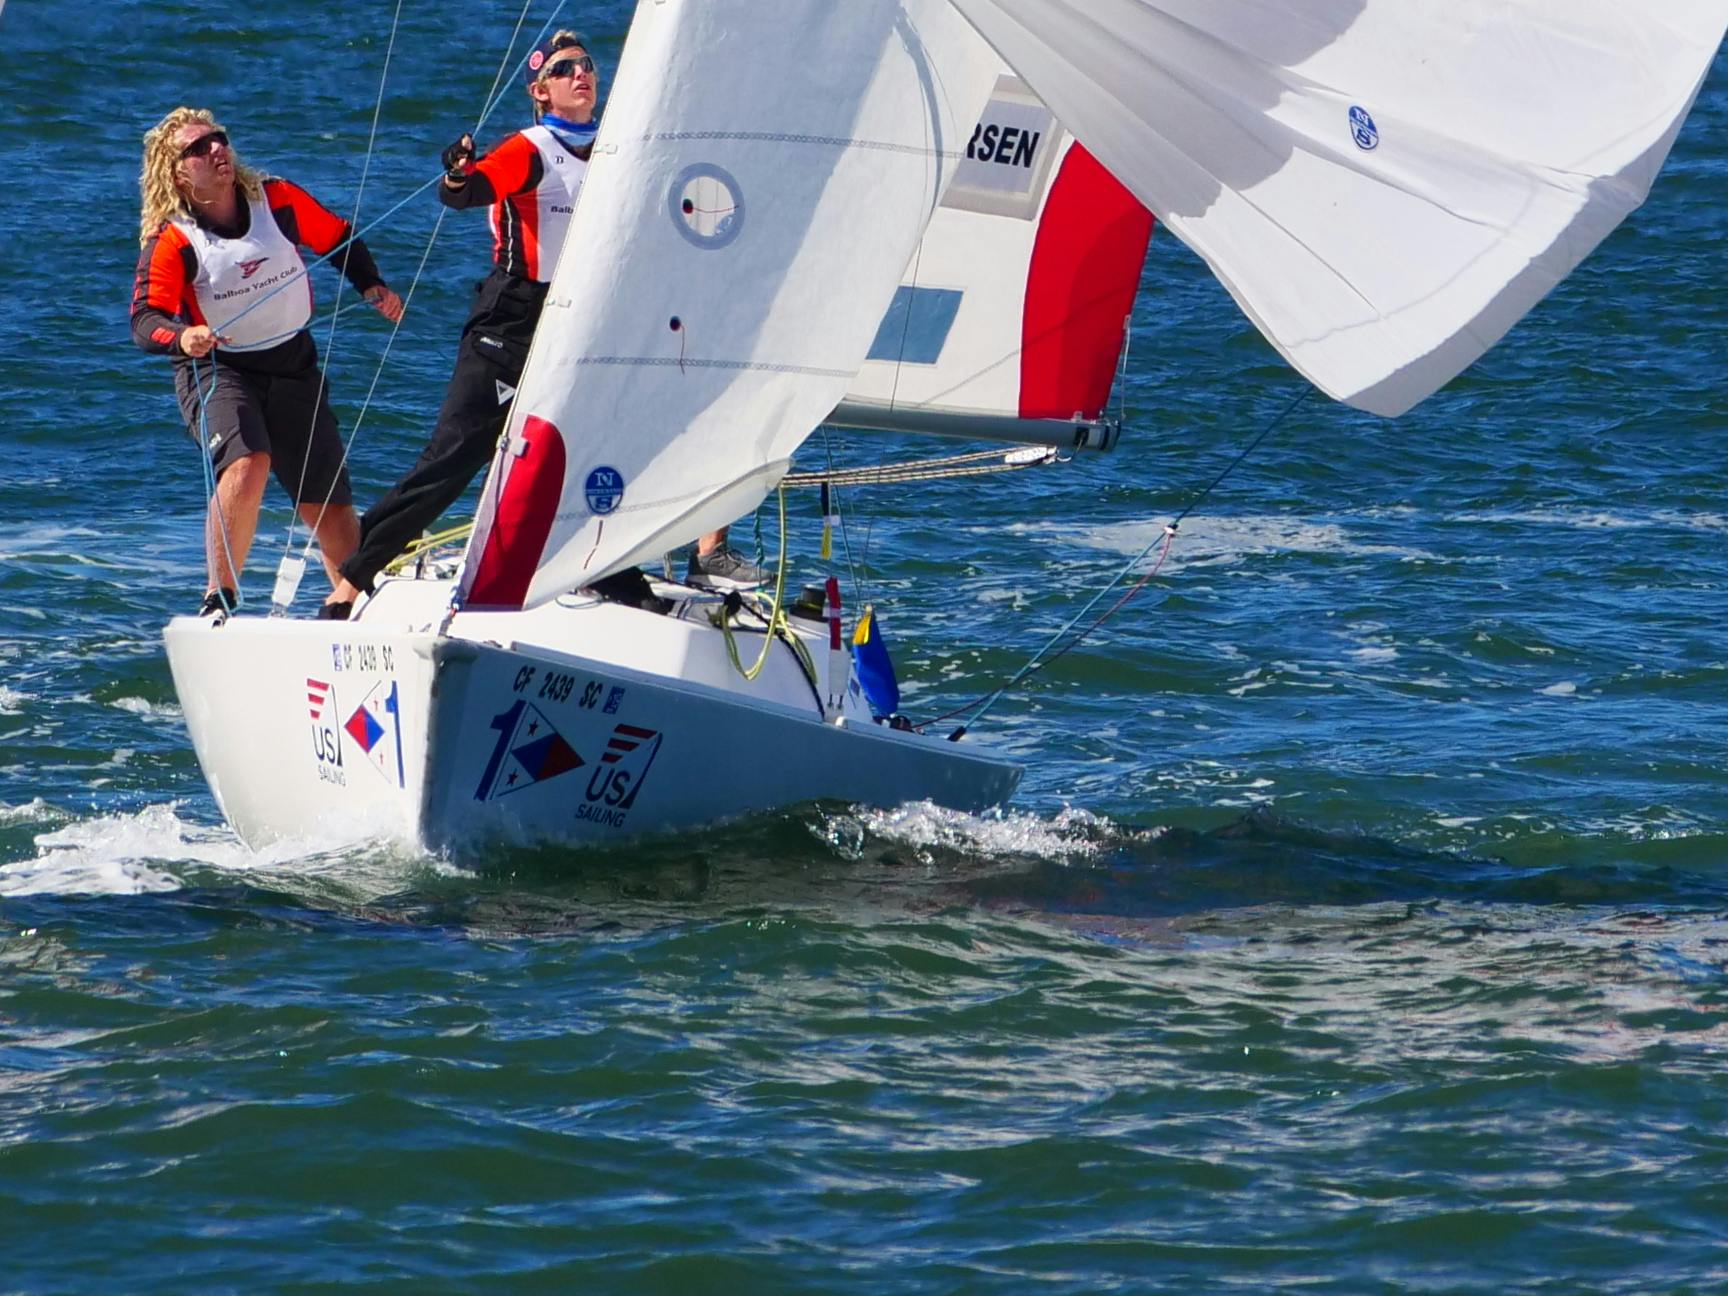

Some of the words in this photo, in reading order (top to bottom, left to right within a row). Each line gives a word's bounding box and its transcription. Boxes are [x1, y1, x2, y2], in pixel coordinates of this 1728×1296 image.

[214, 287, 251, 301] Balboa
[252, 275, 279, 291] Yacht
[280, 266, 298, 279] Club
[595, 472, 614, 487] N
[382, 644, 395, 672] SC
[513, 665, 536, 693] CF
[538, 671, 575, 704] 2439
[579, 680, 603, 710] SC
[385, 680, 406, 789] 1
[473, 699, 527, 802] 1
[575, 803, 627, 828] SAILING
